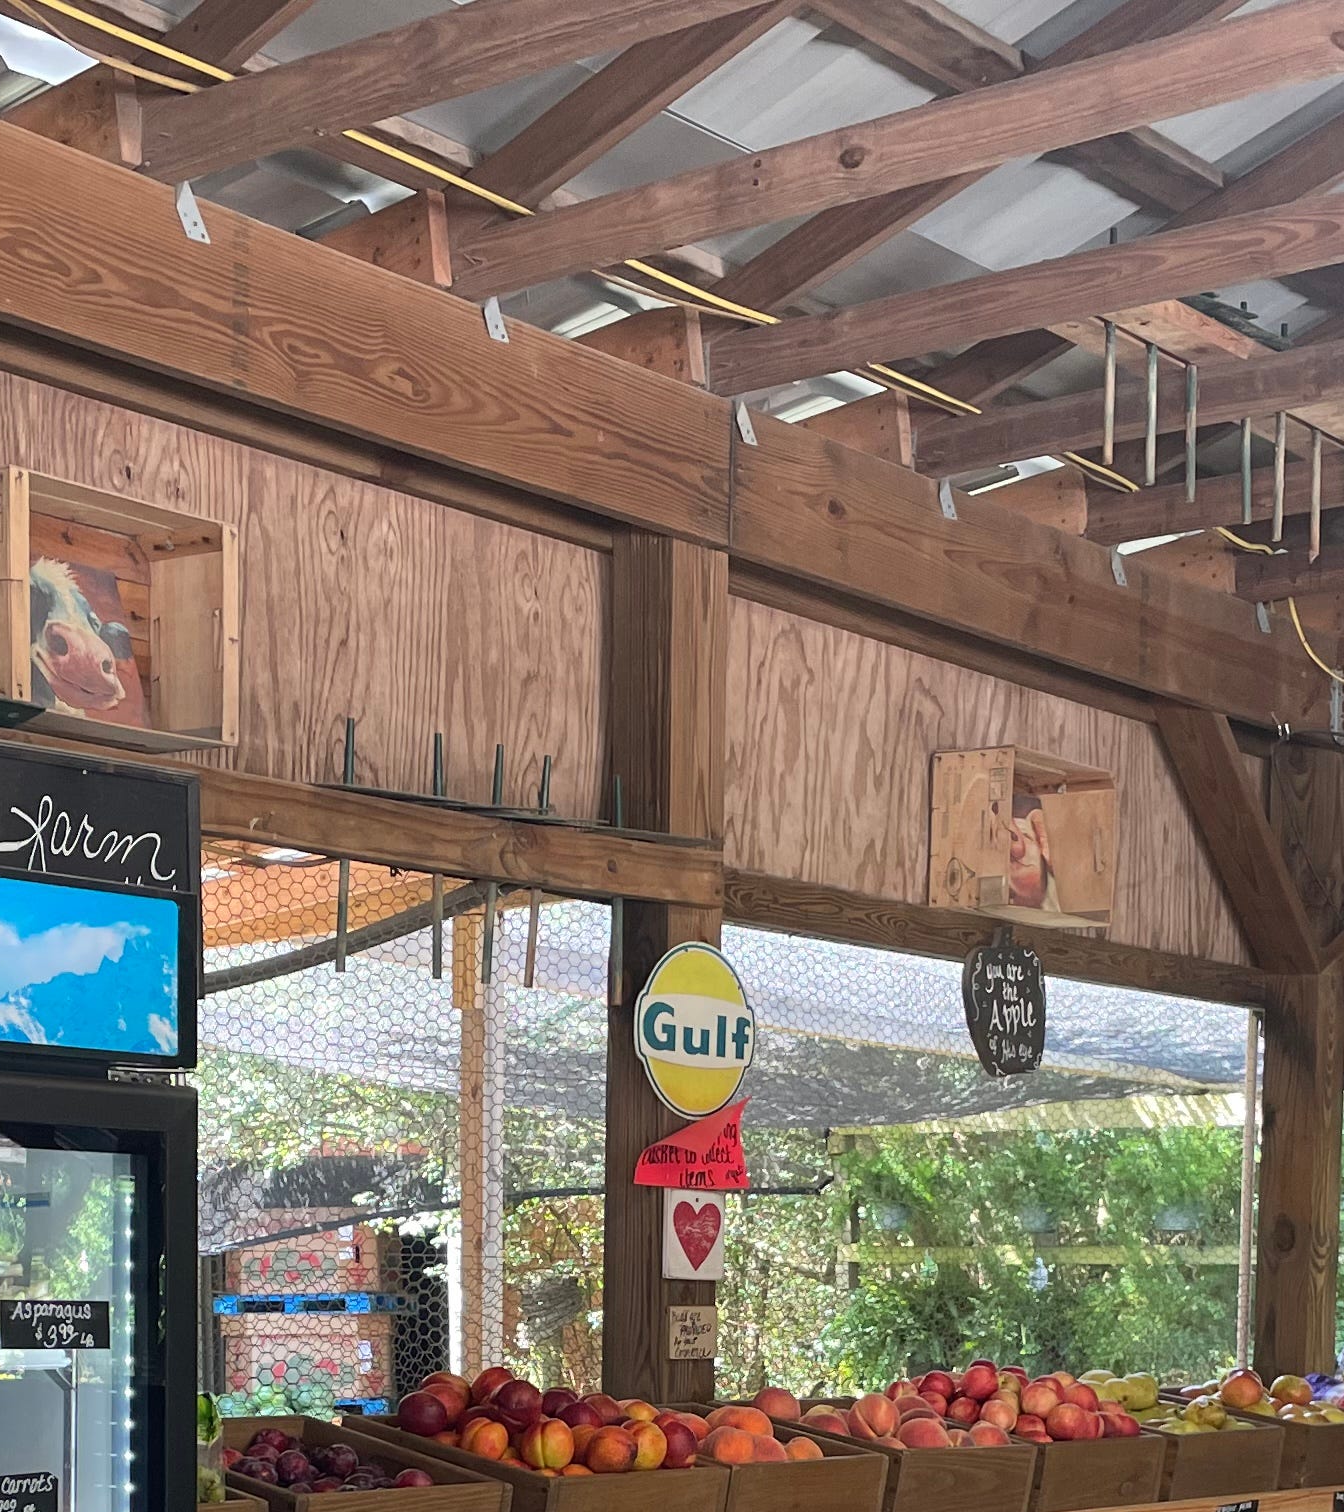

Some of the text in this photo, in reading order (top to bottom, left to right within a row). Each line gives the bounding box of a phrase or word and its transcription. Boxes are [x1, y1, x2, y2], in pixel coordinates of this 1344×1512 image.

[985, 963, 1025, 993] you are
[1002, 981, 1019, 1001] the
[642, 1001, 751, 1060] Gulf
[989, 998, 1036, 1035] Apple
[10, 1301, 93, 1327] Asparagus
